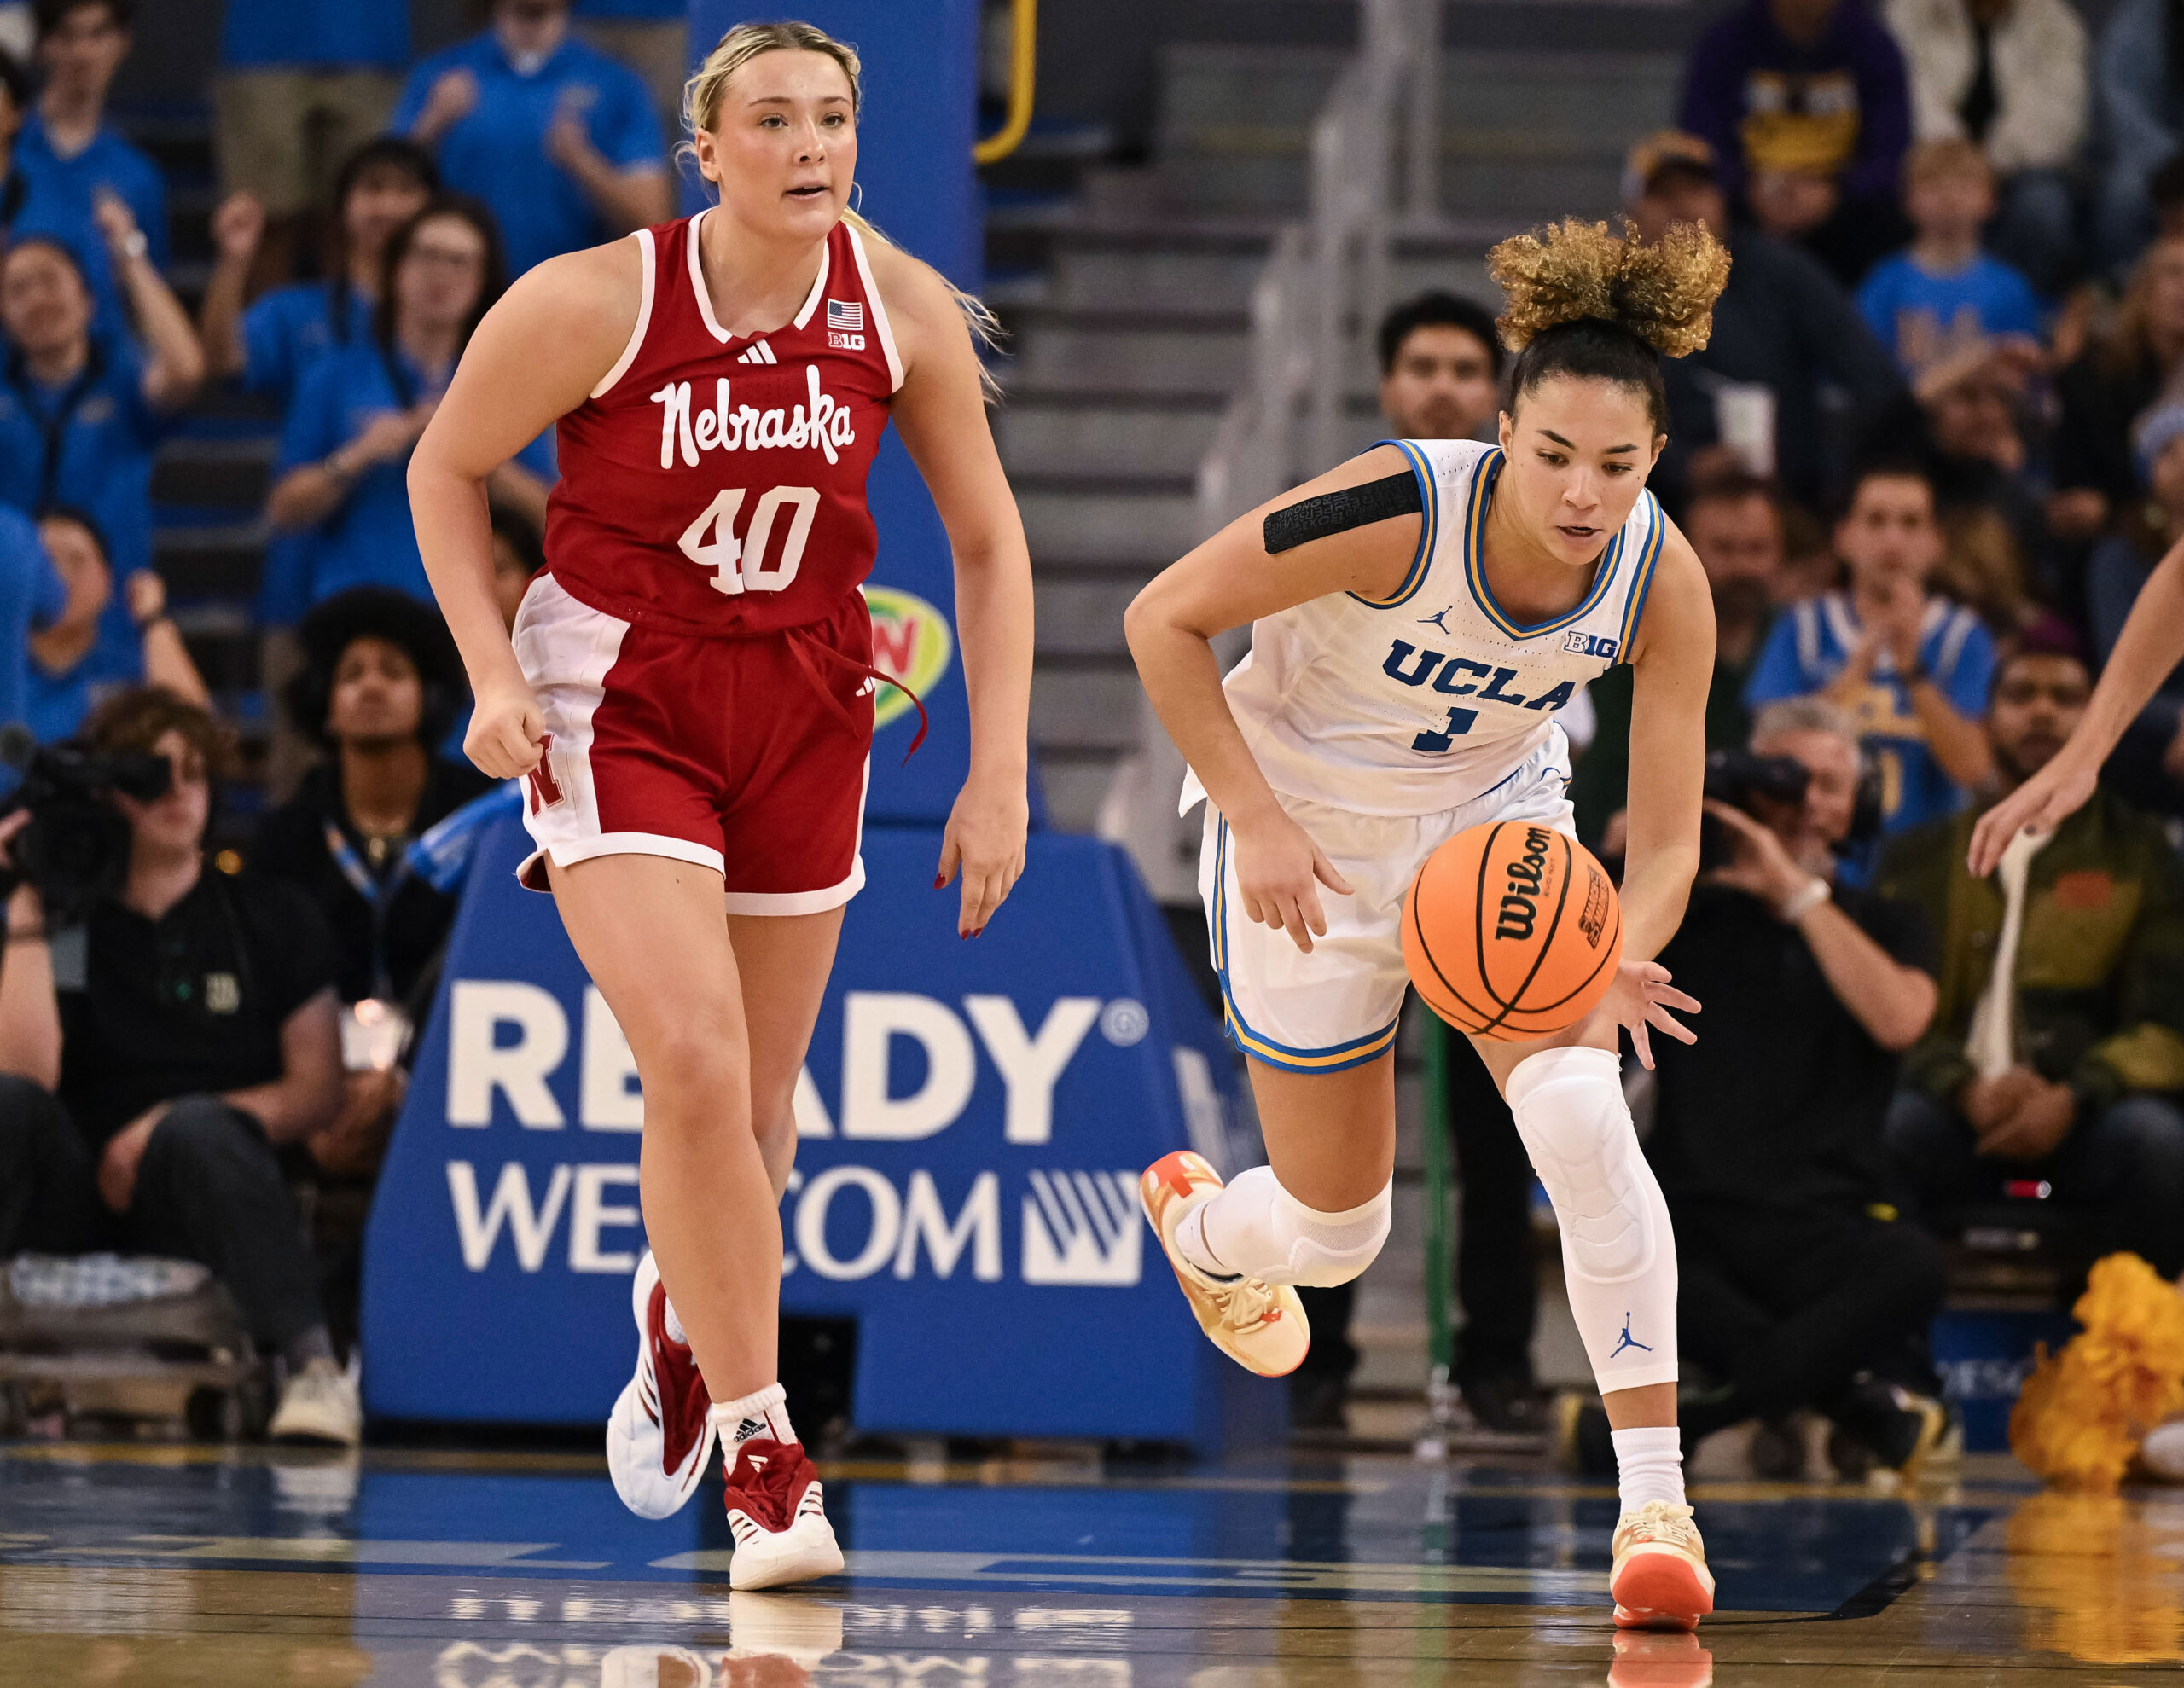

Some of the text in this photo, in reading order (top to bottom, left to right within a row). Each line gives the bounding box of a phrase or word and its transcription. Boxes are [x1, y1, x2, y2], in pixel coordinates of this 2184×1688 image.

[650, 364, 855, 469] Nebraska
[677, 485, 821, 595] 40
[1278, 498, 1321, 520] STRONG
[1382, 638, 1576, 711] UCLA
[1411, 707, 1479, 752] 1
[1495, 827, 1551, 941] Wilson
[733, 1423, 767, 1442] adidas
